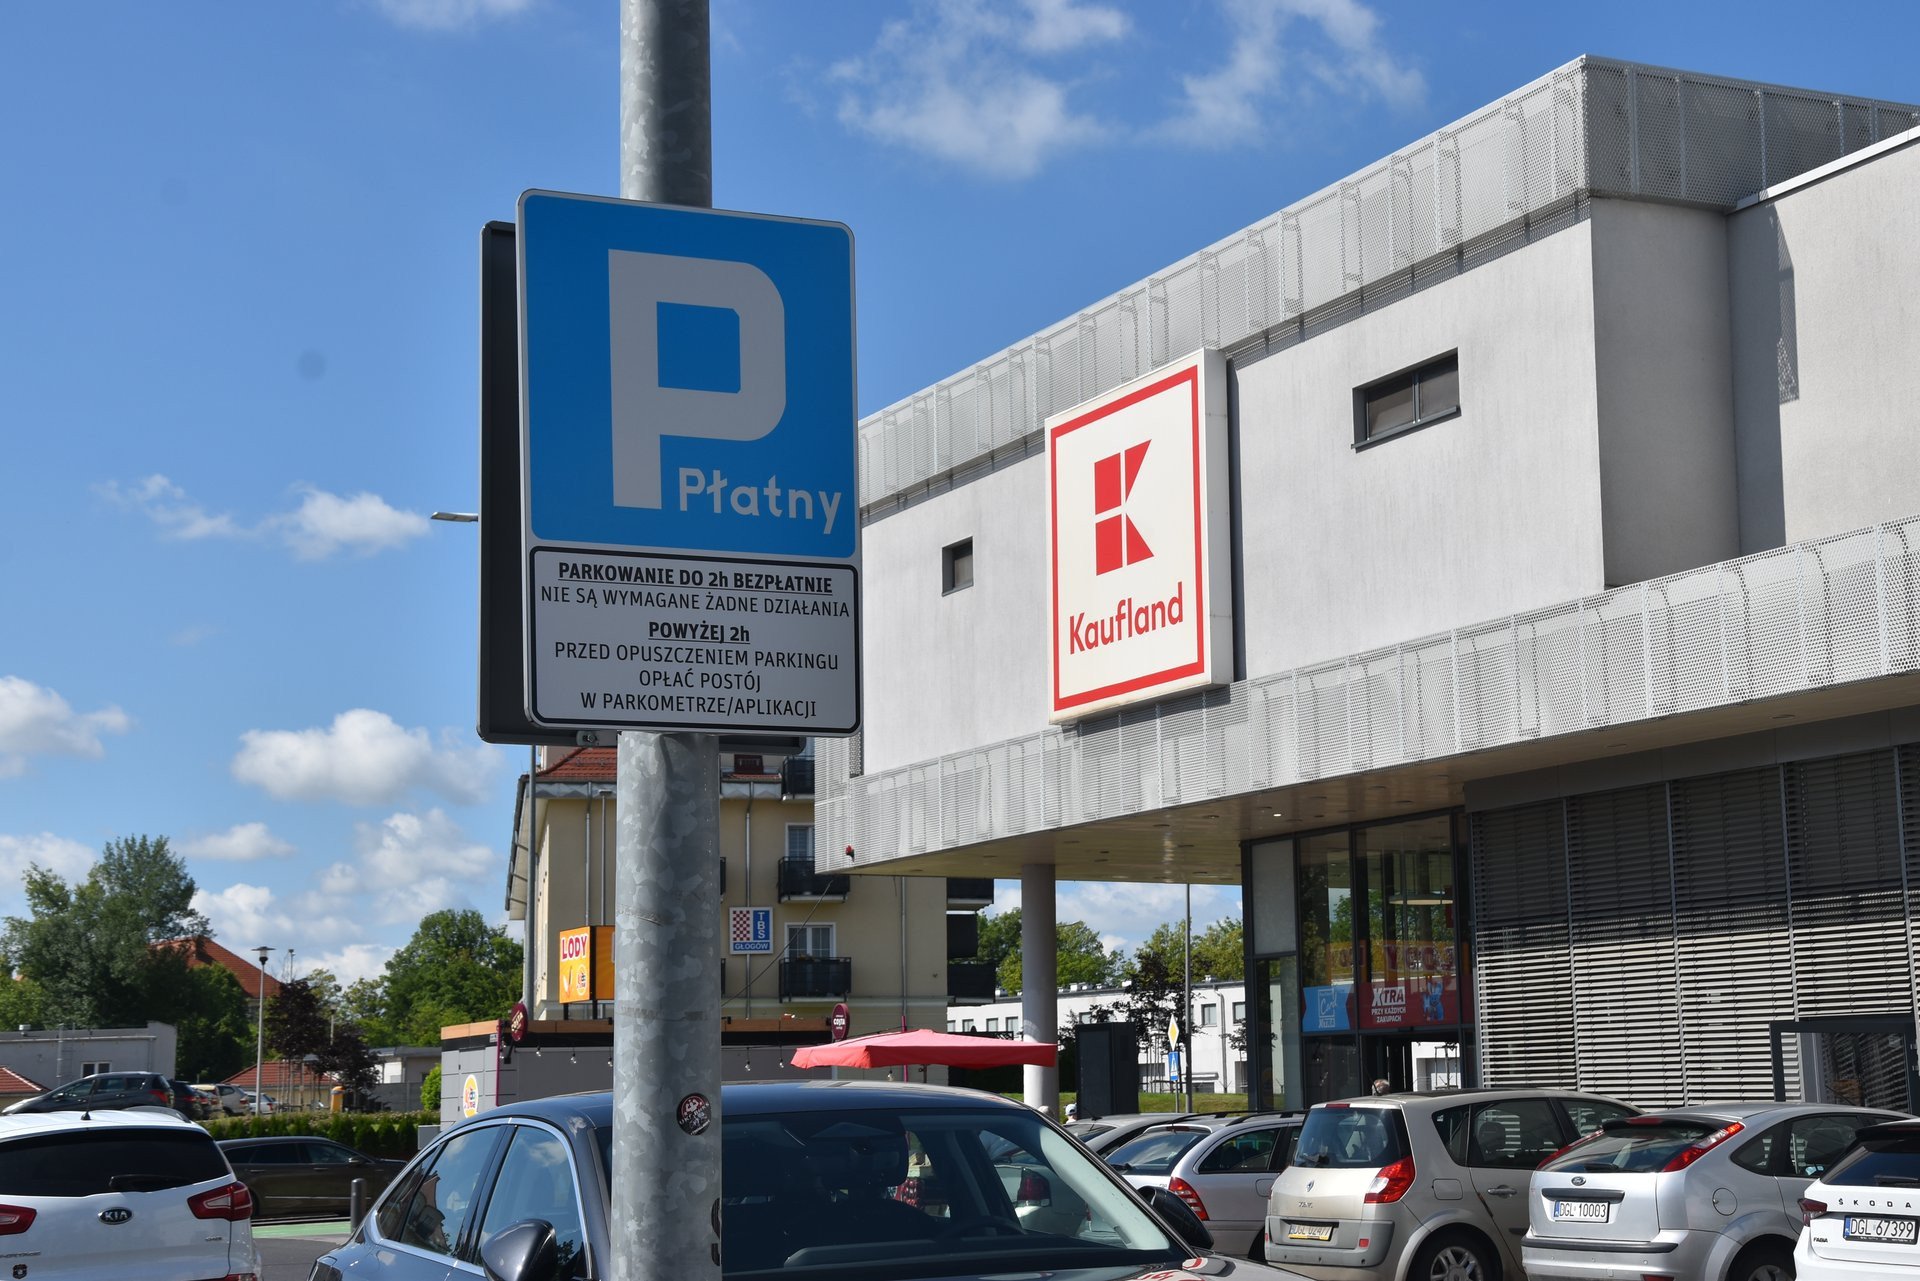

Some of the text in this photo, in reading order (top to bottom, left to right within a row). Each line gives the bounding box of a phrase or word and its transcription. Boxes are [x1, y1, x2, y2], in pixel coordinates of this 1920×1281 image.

[608, 248, 787, 510] P
[679, 467, 842, 535] Płatny
[559, 562, 833, 593] PARKOWANIE DO 2h BEZPŁATNIE
[541, 586, 850, 617] NIE SĄ WYMAGANE ŻADNE DZIAŁANIA
[649, 620, 750, 643] POWYŻEJ 2h
[1069, 581, 1184, 655] Kaufland
[555, 642, 838, 670] PRZED OPUSZCZENIEM PARKINGU
[639, 668, 761, 693] OPŁAĆ POSTÓJ
[581, 692, 817, 719] W PARKOMETRZE/APLIKACJI
[561, 934, 588, 961] LODY
[1371, 986, 1406, 1007] XTRA
[104, 1211, 128, 1221] KIA
[1579, 1203, 1606, 1218] 10003
[1851, 1219, 1914, 1237] DGL 67399
